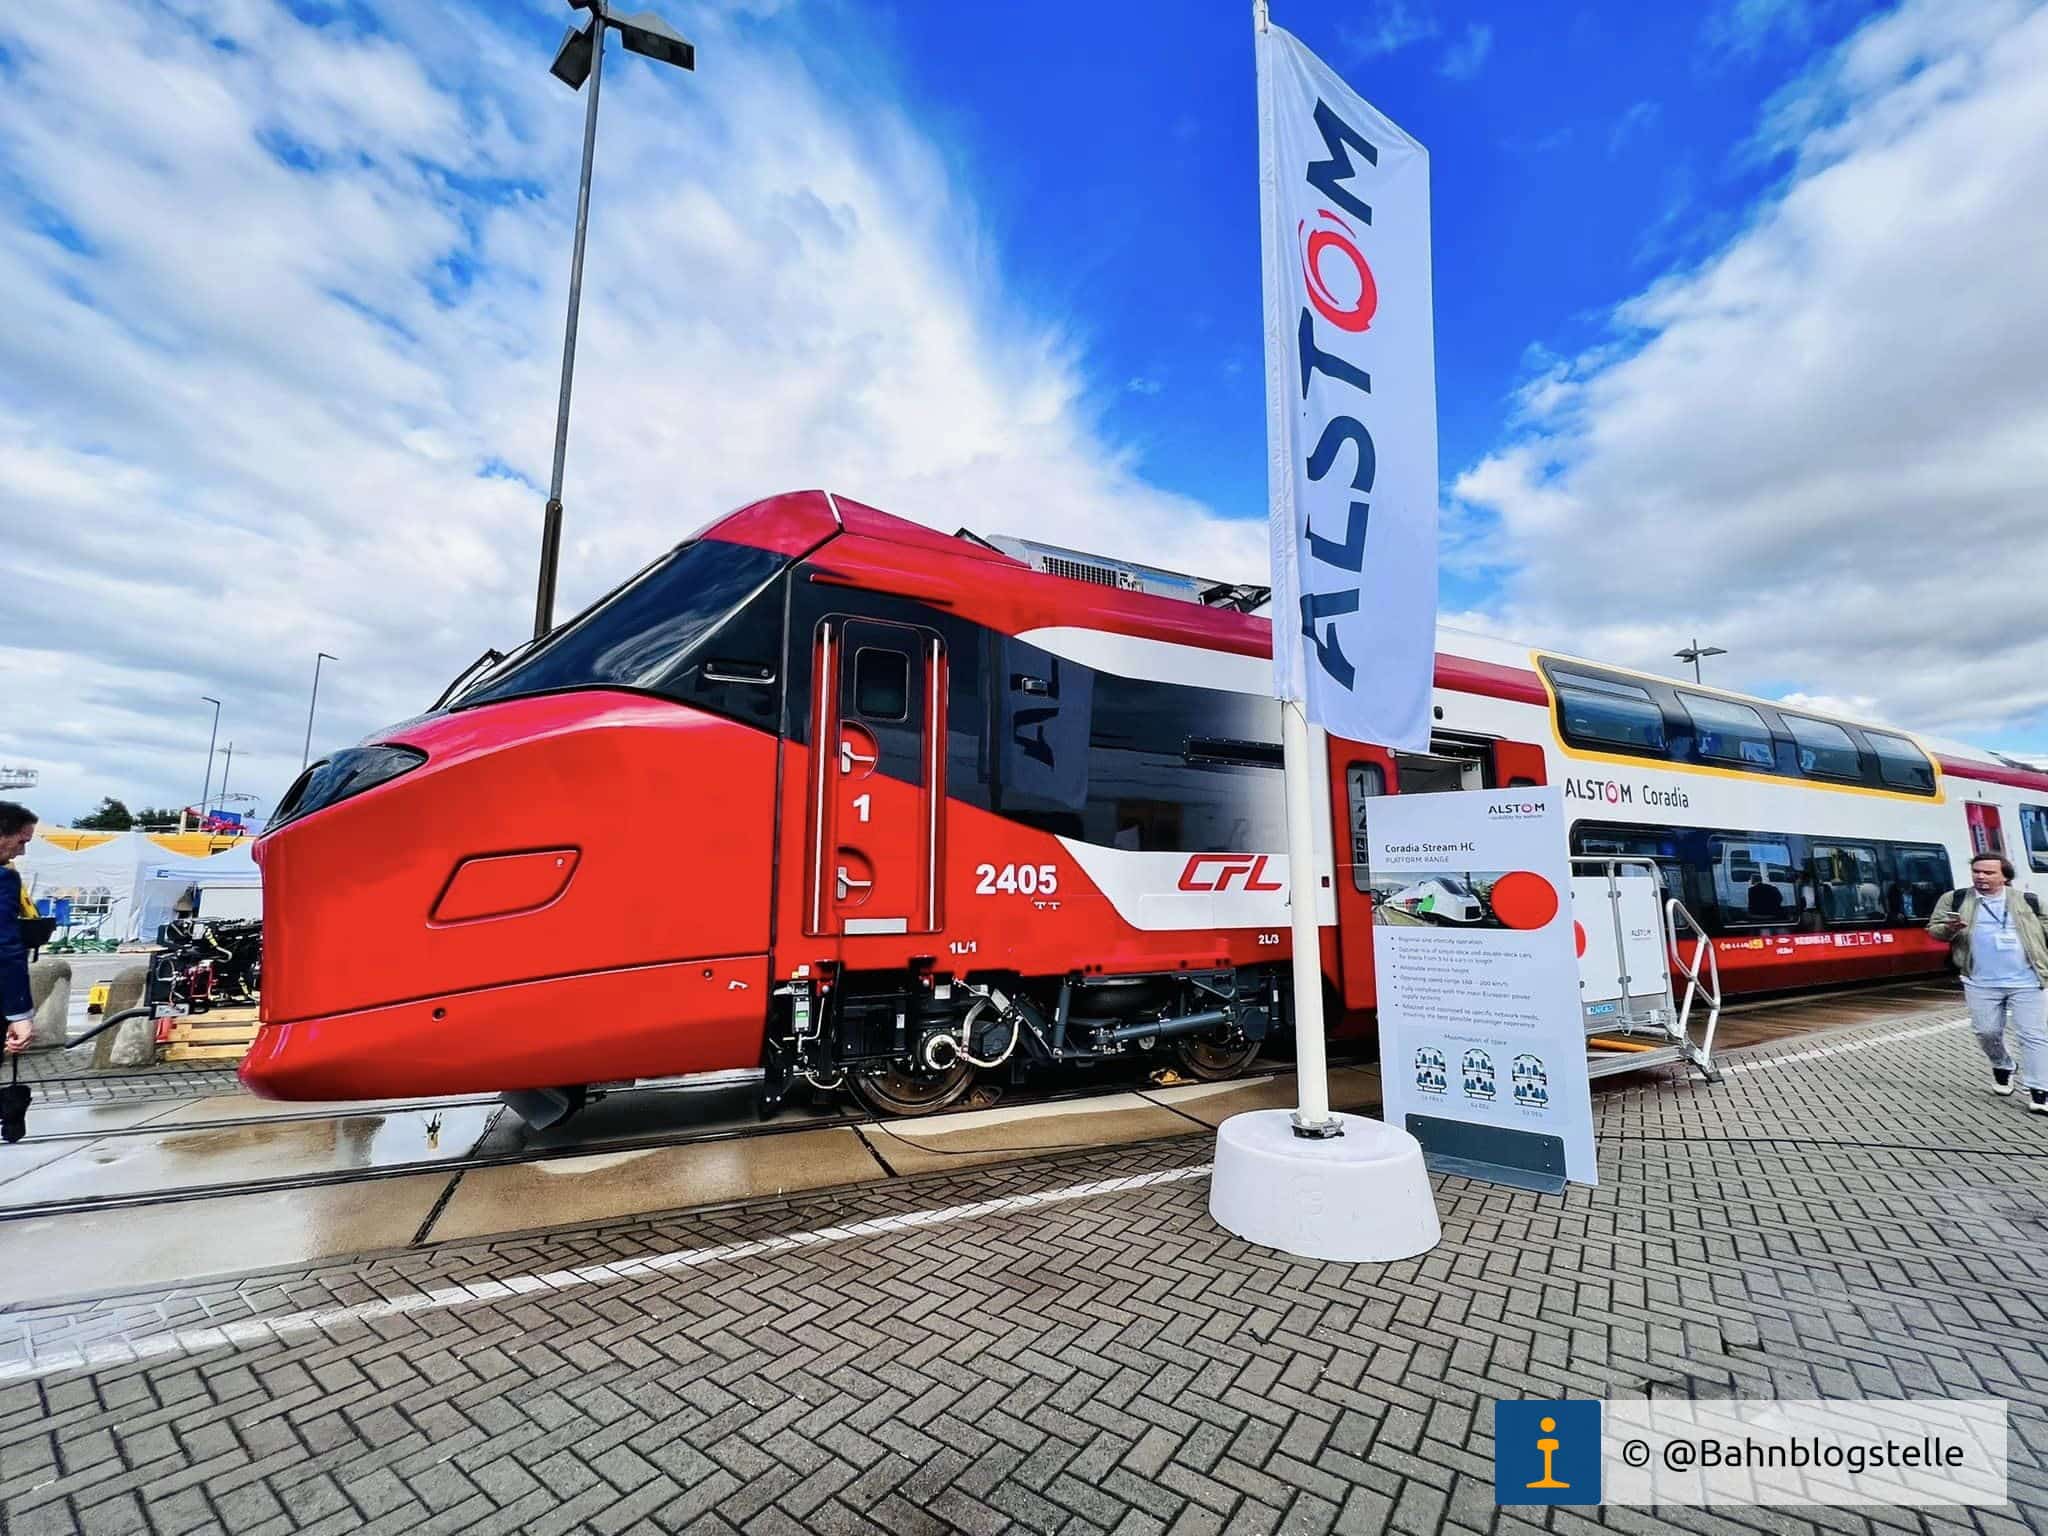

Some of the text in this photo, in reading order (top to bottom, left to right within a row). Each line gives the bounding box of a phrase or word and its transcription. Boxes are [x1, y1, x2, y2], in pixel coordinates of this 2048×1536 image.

[1299, 97, 1379, 692] ALSTOM
[1565, 777, 1689, 808] ALSTOM Coradia
[853, 794, 871, 822] 1
[1488, 803, 1545, 814] ALSTOM
[1384, 841, 1476, 853] Coradia Stream HC
[975, 863, 1058, 895] 2405
[1178, 854, 1282, 891] CFL
[949, 940, 977, 955] 1L/1
[1258, 934, 1280, 945] 2L/3
